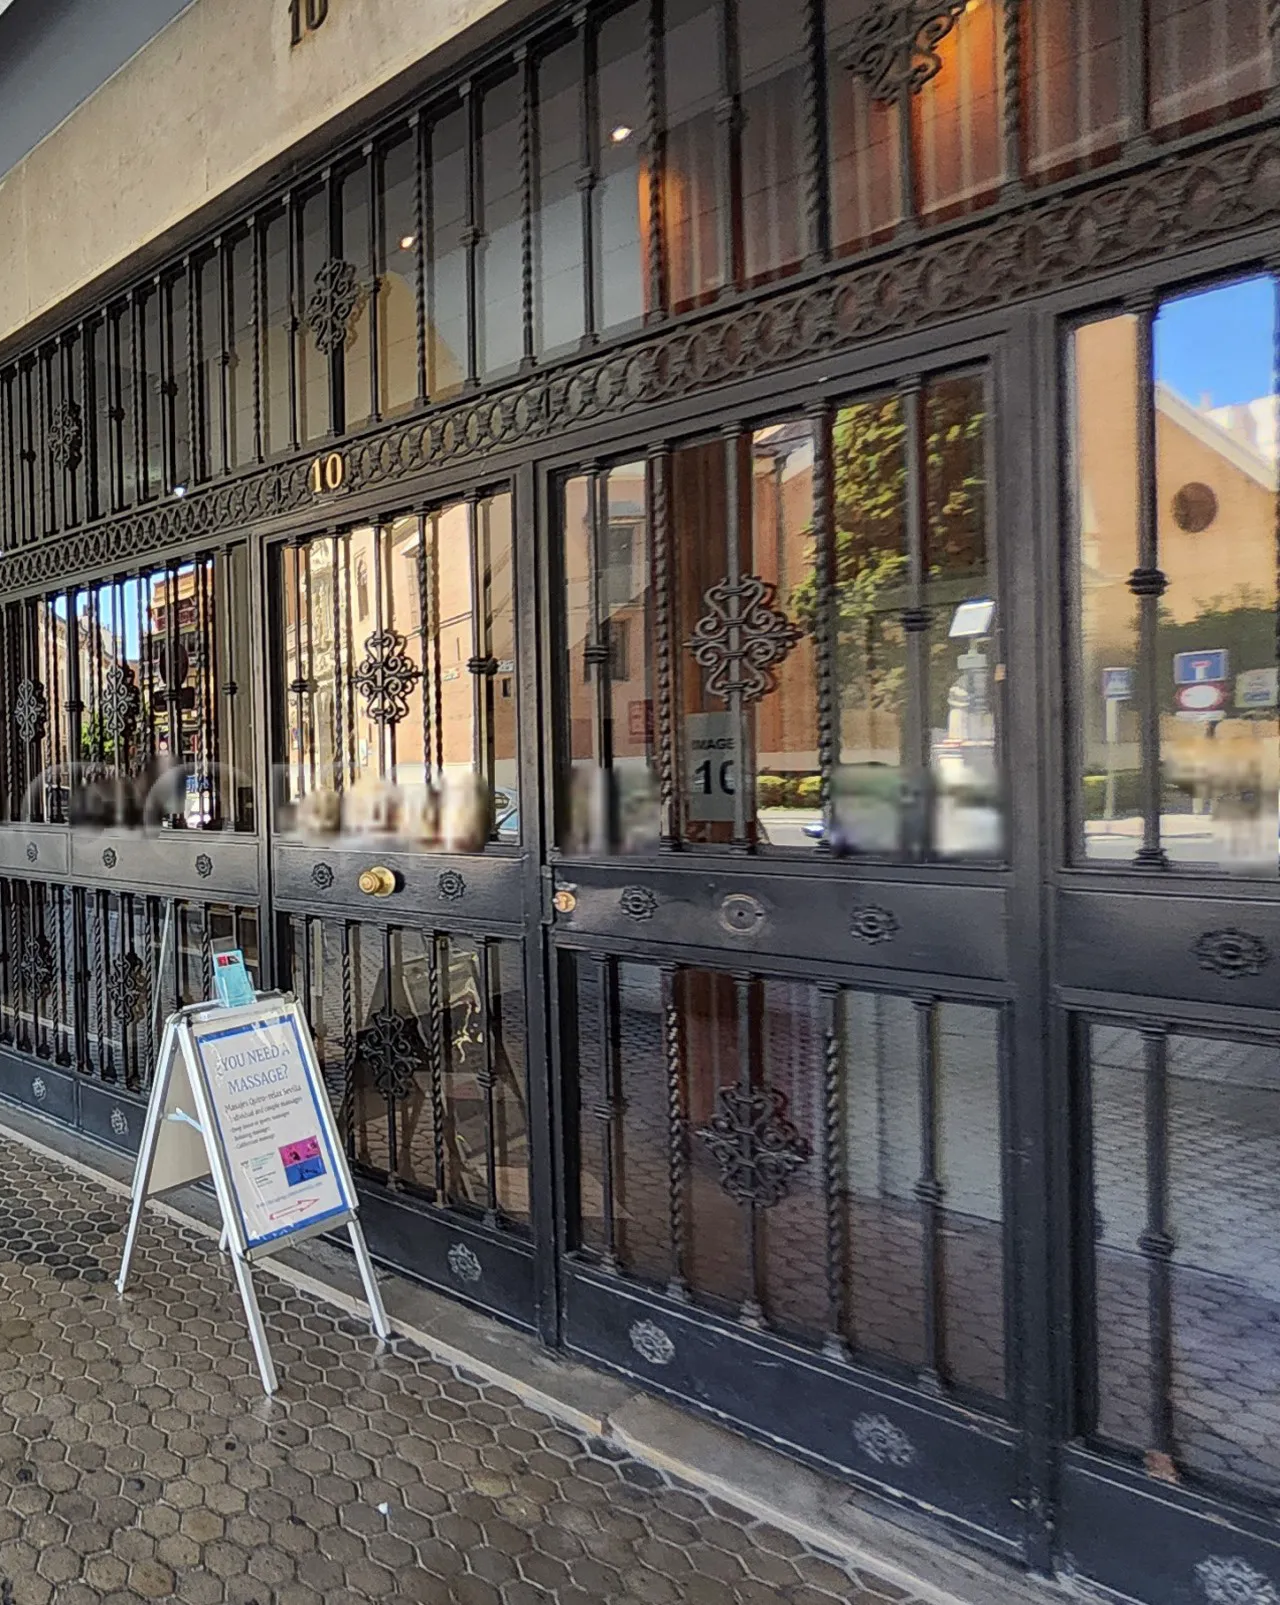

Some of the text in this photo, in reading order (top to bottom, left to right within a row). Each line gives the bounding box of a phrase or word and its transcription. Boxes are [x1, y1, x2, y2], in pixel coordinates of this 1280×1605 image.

[311, 452, 343, 493] 10
[691, 737, 736, 751] IMAGE
[246, 1044, 280, 1065] NEED
[279, 1042, 291, 1056] A
[227, 1063, 289, 1096] MASSAGE?
